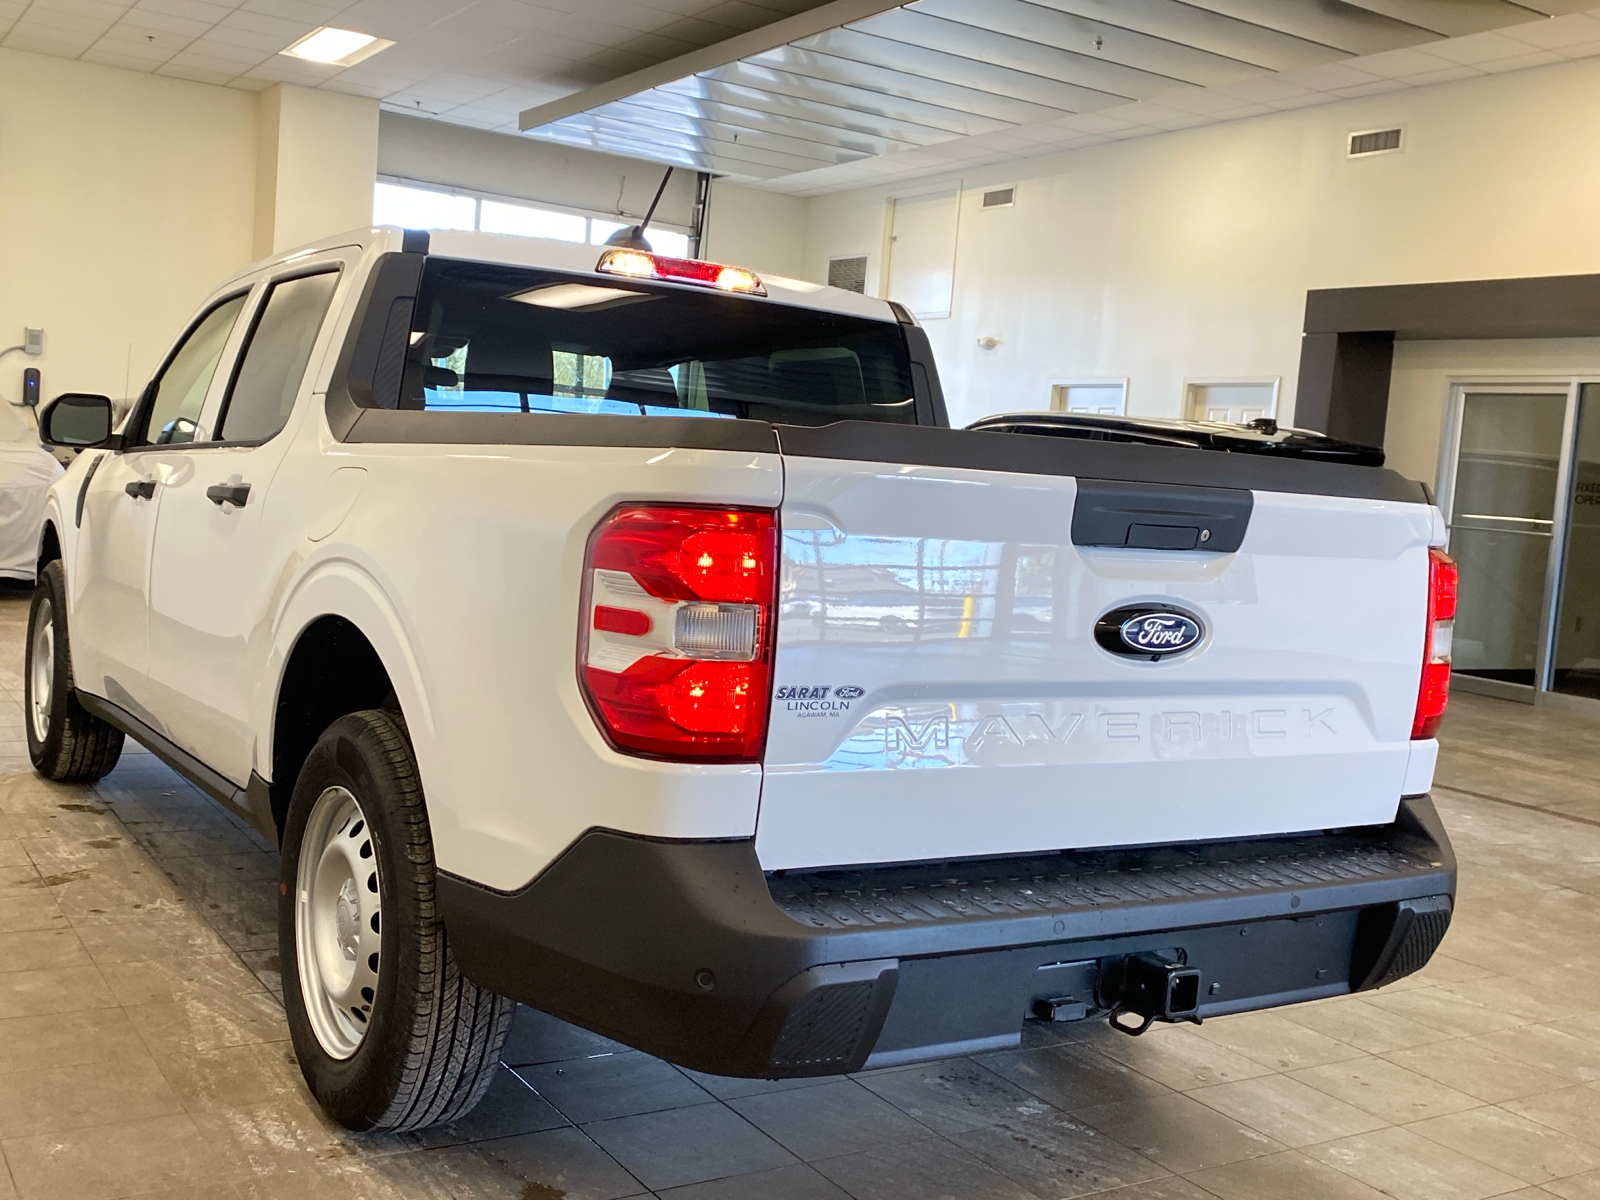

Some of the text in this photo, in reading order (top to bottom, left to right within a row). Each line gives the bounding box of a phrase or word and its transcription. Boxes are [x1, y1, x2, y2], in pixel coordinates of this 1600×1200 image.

[1138, 618, 1185, 645] Ford
[775, 686, 861, 700] SARAT Ford
[787, 701, 850, 711] LINCOLN
[886, 708, 1338, 751] MAVERICK
